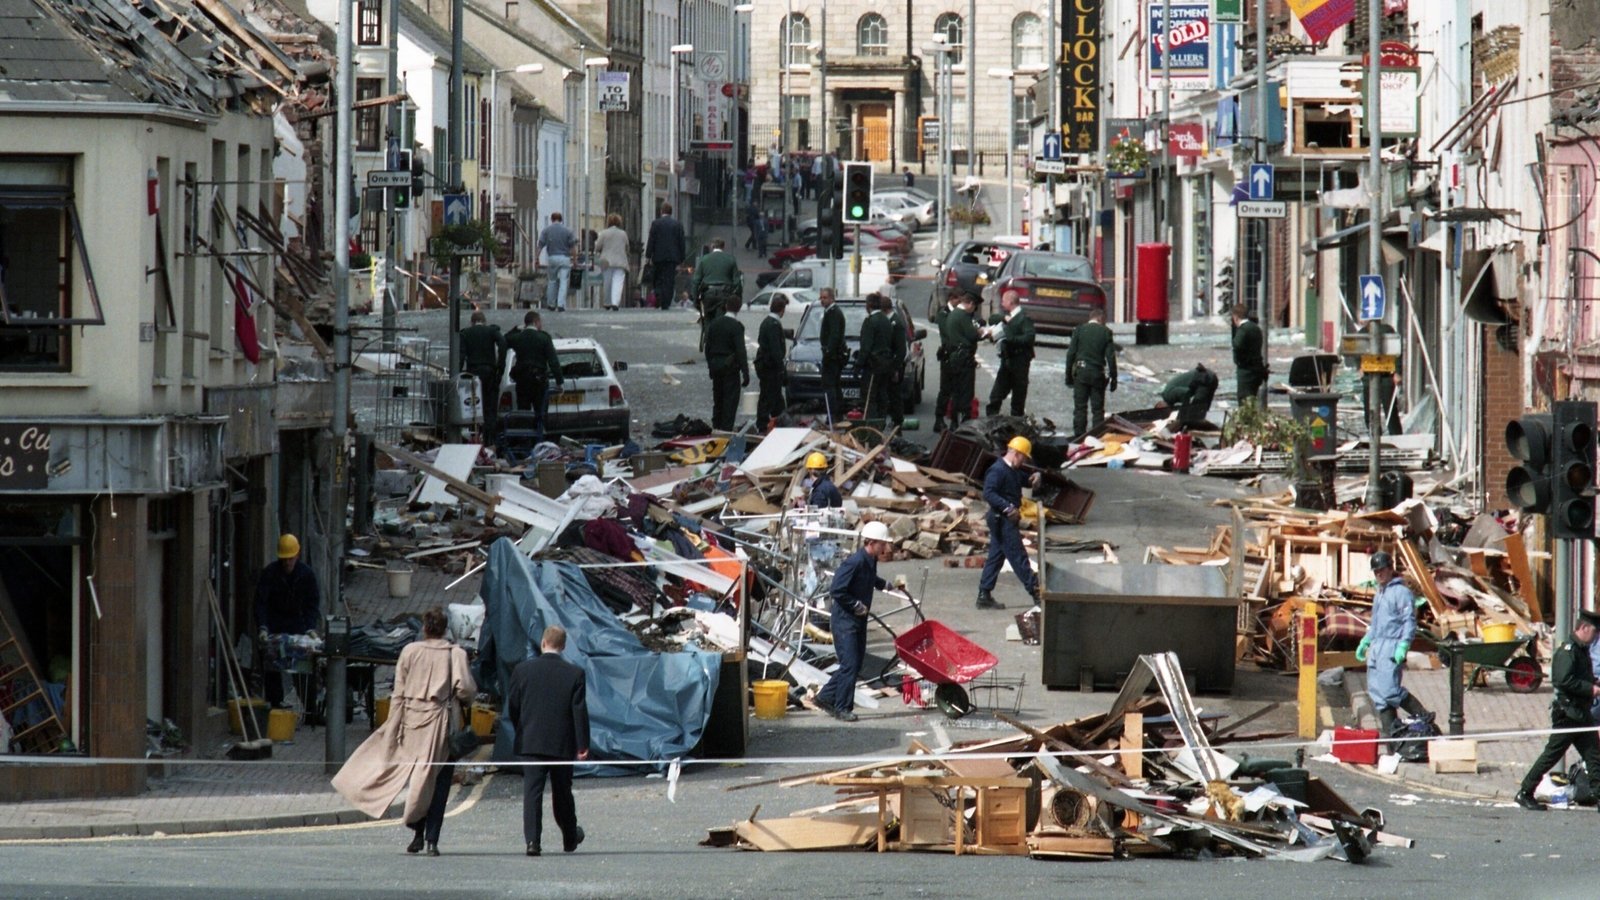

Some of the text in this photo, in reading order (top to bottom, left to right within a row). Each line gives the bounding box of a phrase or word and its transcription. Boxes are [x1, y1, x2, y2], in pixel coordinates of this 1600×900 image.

[1151, 8, 1209, 18] INESTMENT
[1073, 0, 1096, 109] CLOCK
[1075, 112, 1094, 122] BAR
[371, 174, 389, 183] One
[1241, 204, 1283, 215] One way
